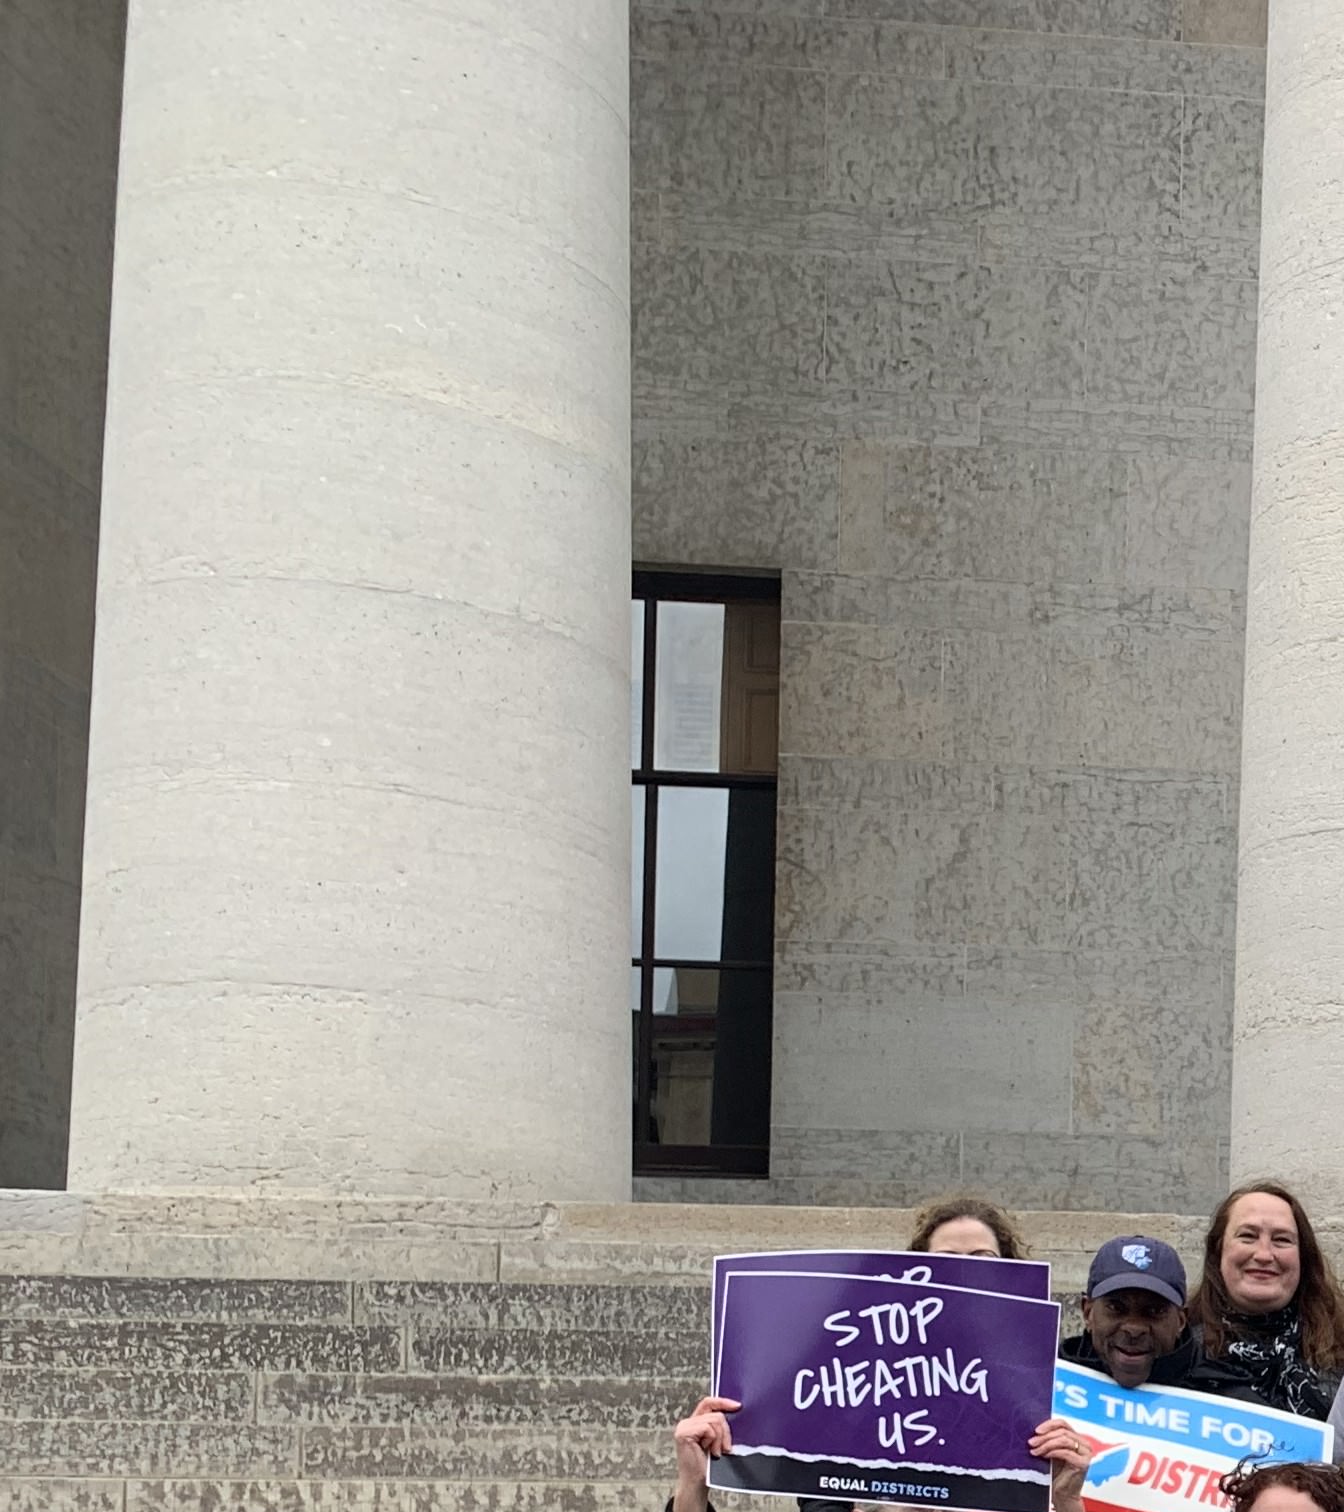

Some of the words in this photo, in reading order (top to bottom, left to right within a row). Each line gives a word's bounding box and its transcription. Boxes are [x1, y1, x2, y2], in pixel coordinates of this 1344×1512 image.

[824, 1297, 943, 1347] STOP
[794, 1348, 988, 1409] CHEATING
[878, 1409, 945, 1454] US.
[1099, 1393, 1190, 1434] TIME
[1201, 1416, 1274, 1456] FOR
[819, 1477, 868, 1491] EQUAL
[871, 1481, 949, 1498] DISTRICTS
[1128, 1451, 1228, 1508] DISTR
